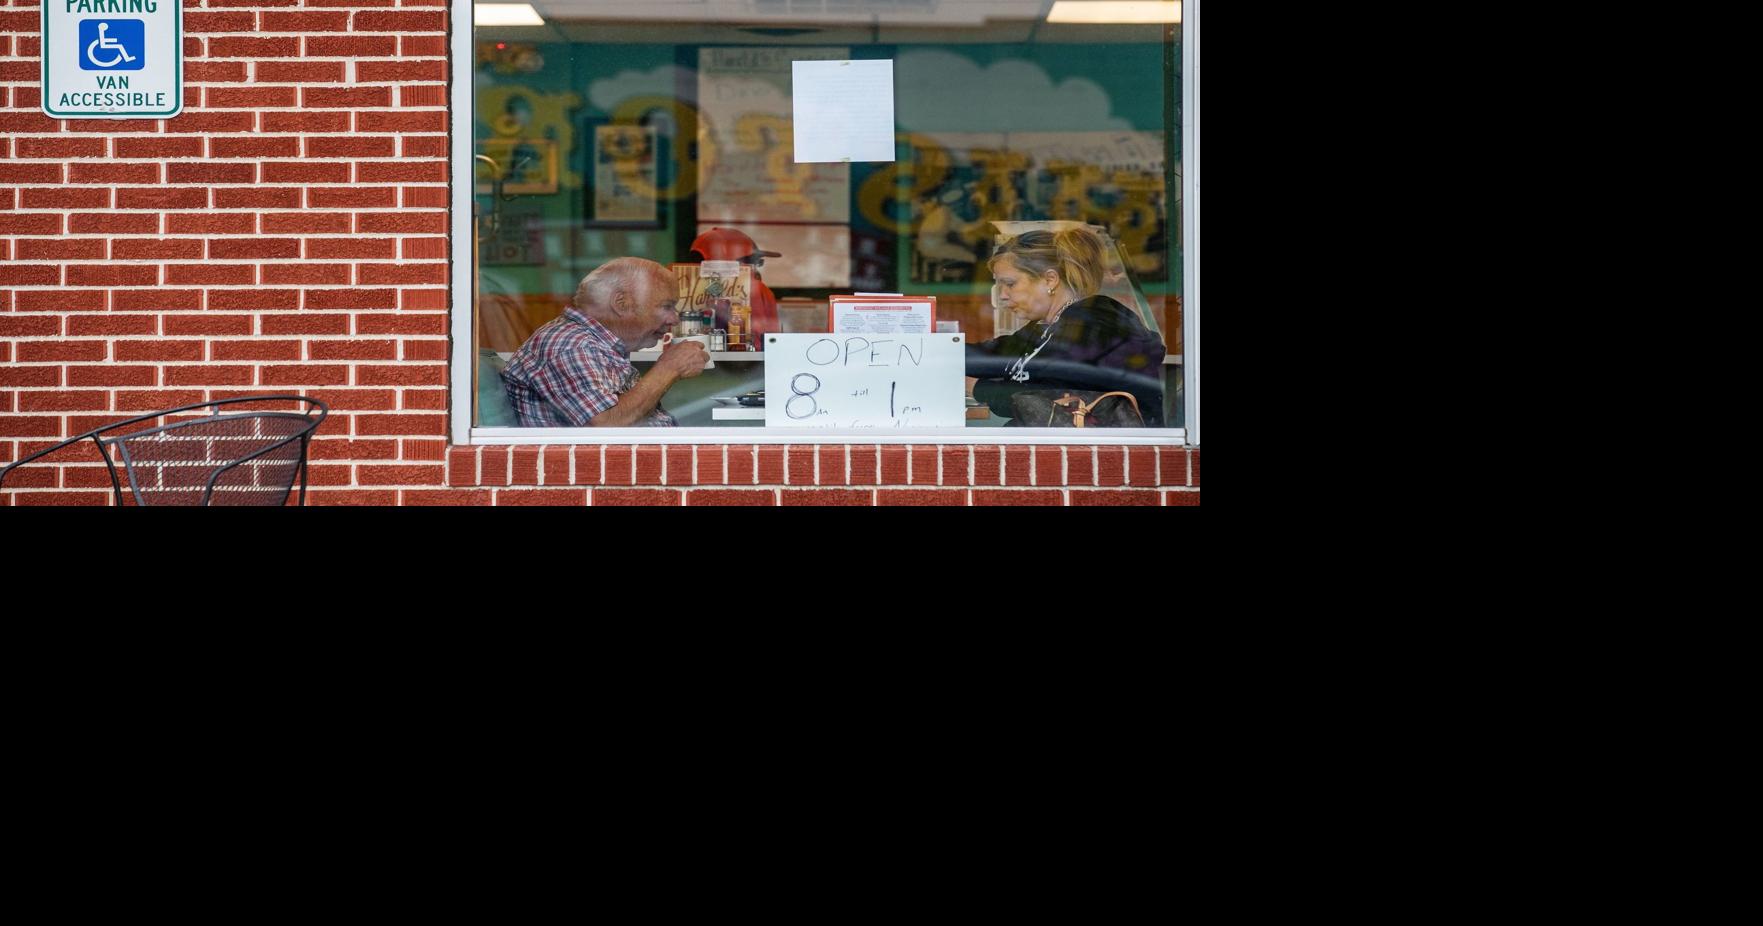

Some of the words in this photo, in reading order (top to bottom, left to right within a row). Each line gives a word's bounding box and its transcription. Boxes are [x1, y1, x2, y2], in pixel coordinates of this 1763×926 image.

[66, 0, 157, 13] PARKING
[96, 76, 129, 89] VAN
[59, 93, 165, 106] ACCESSIBLE
[677, 273, 749, 312] Harld's
[806, 336, 924, 366] OPEN
[890, 381, 896, 418] 1
